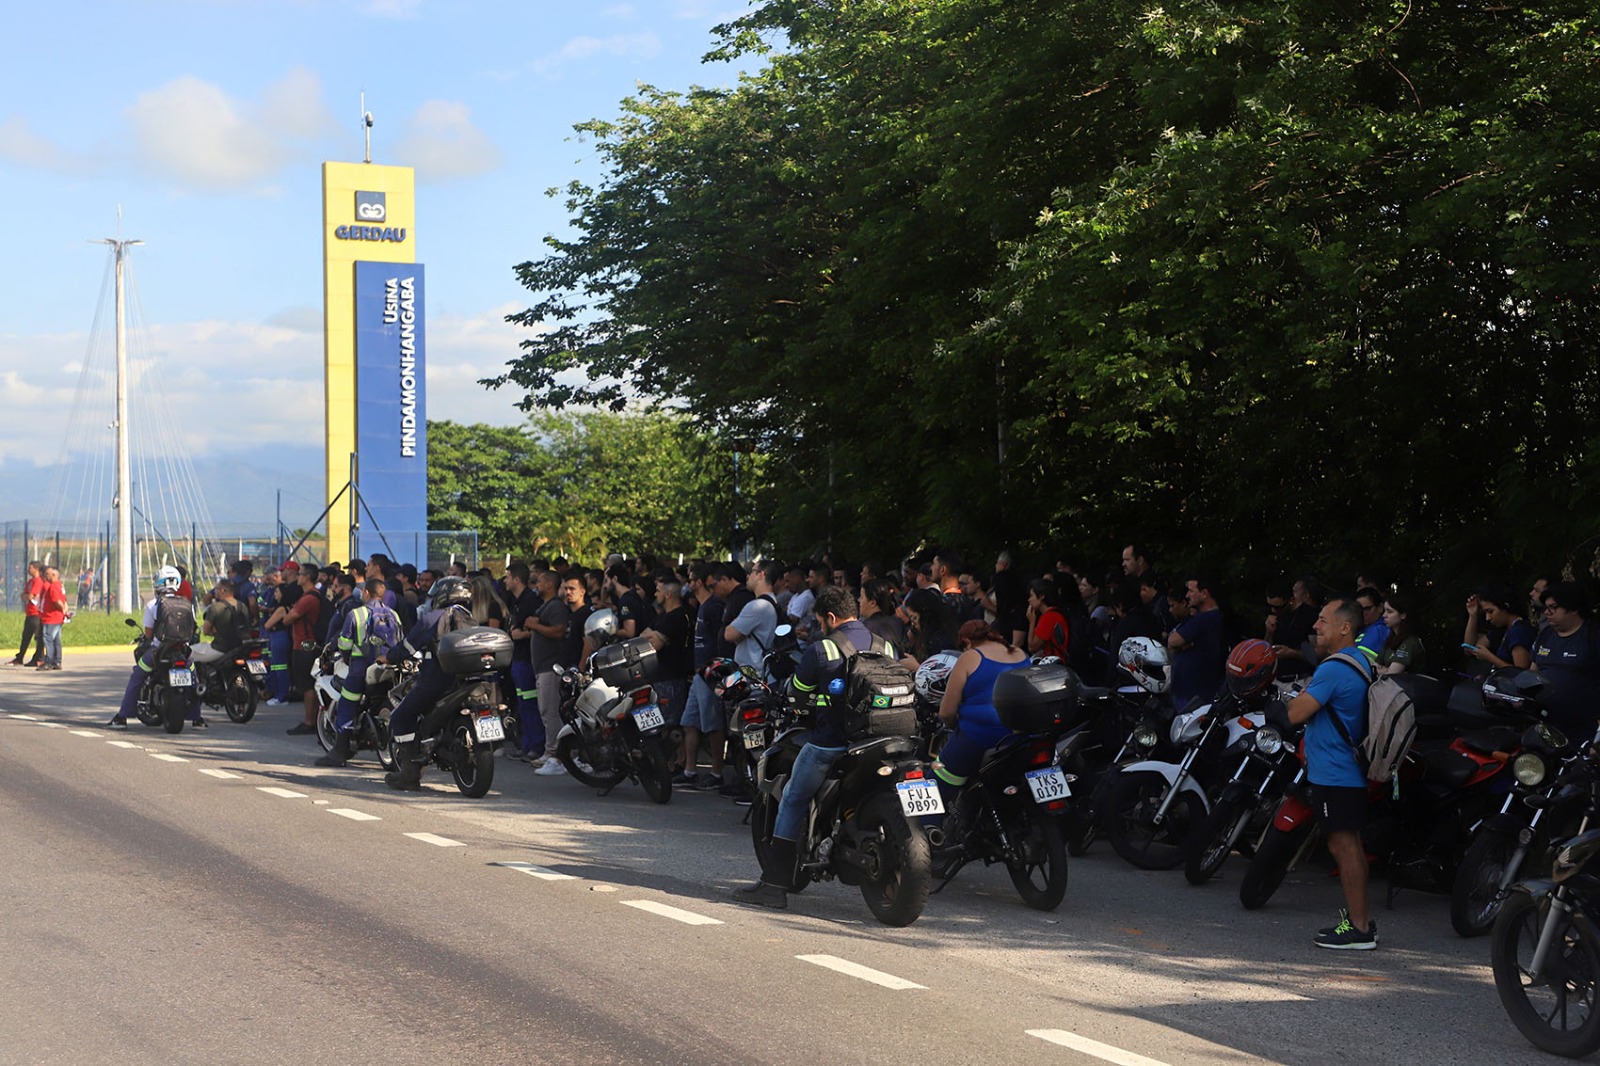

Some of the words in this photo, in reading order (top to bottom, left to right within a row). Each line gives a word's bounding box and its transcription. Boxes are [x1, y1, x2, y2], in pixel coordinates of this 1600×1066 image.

[335, 225, 406, 242] GERDAU
[384, 277, 398, 323] USINA
[400, 276, 416, 457] PINDAMONHANGABA
[639, 710, 656, 720] FWG
[641, 715, 661, 729] 2E10
[1035, 773, 1058, 788] TKS
[907, 787, 932, 800] FVI
[907, 799, 938, 813] 9B99
